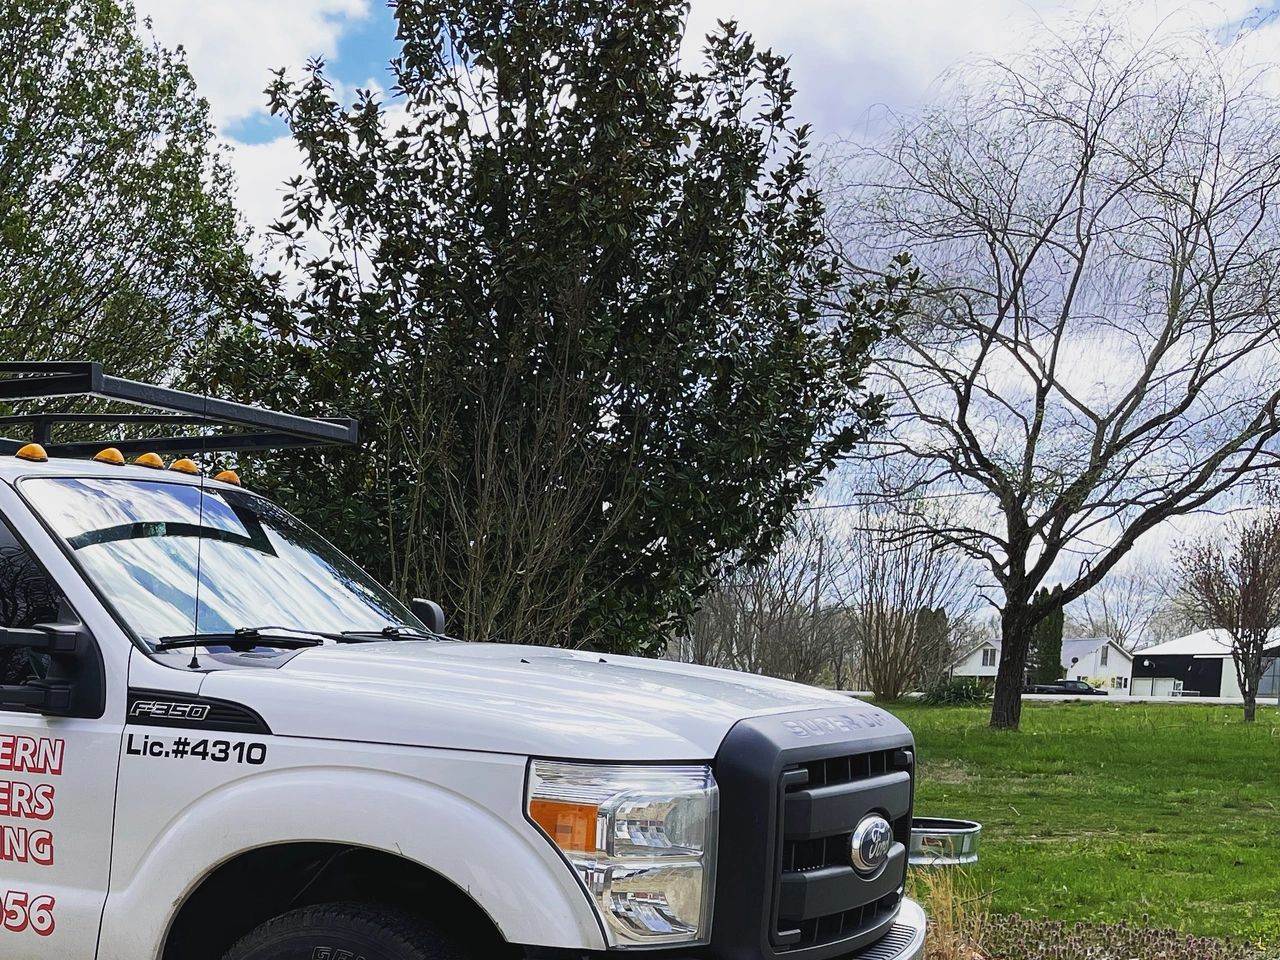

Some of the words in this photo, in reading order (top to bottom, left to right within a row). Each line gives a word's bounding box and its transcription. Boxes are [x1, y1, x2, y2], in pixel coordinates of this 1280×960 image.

[783, 715, 862, 738] SUPER
[856, 713, 888, 728] DU
[126, 734, 267, 765] Lic.#4310
[869, 827, 889, 860] Ford
